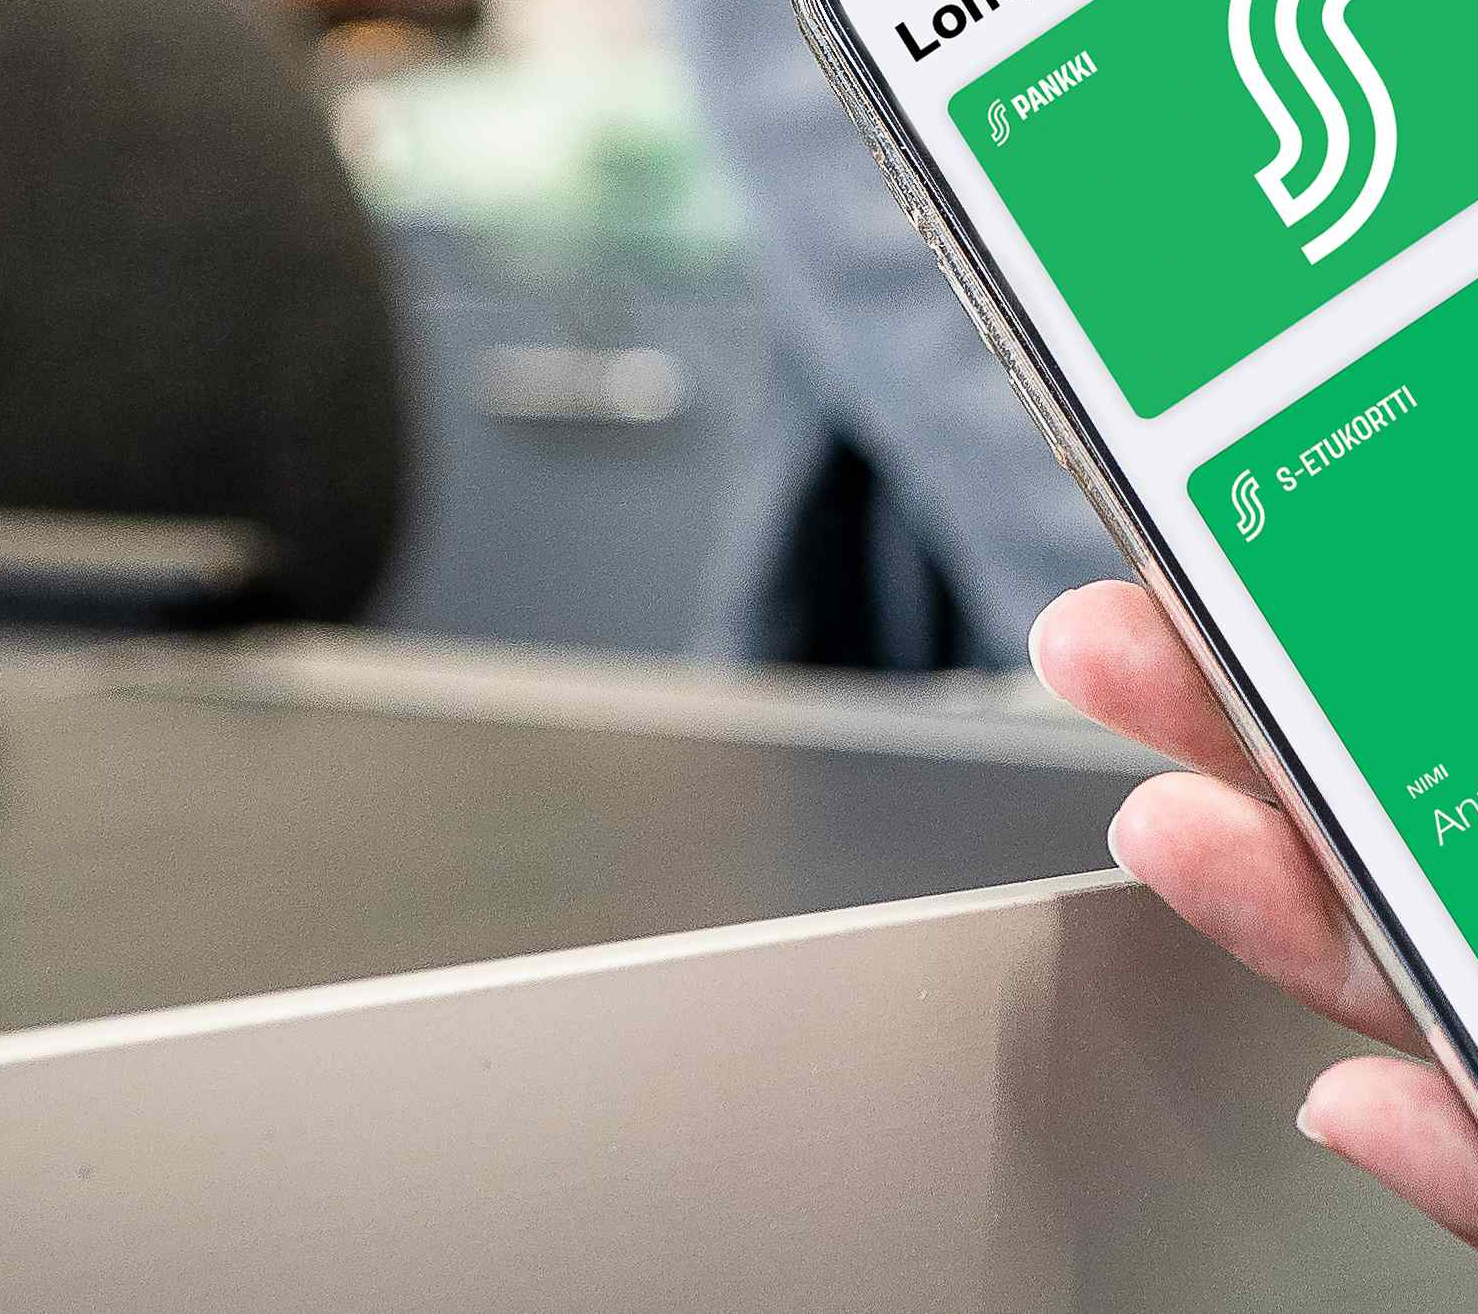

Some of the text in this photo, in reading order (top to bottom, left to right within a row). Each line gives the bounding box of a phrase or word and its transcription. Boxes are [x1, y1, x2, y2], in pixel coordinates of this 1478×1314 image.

[1010, 50, 1098, 121] PANKKI
[1275, 384, 1418, 492] S-ETUKORTTI
[1406, 764, 1449, 799] NIMI
